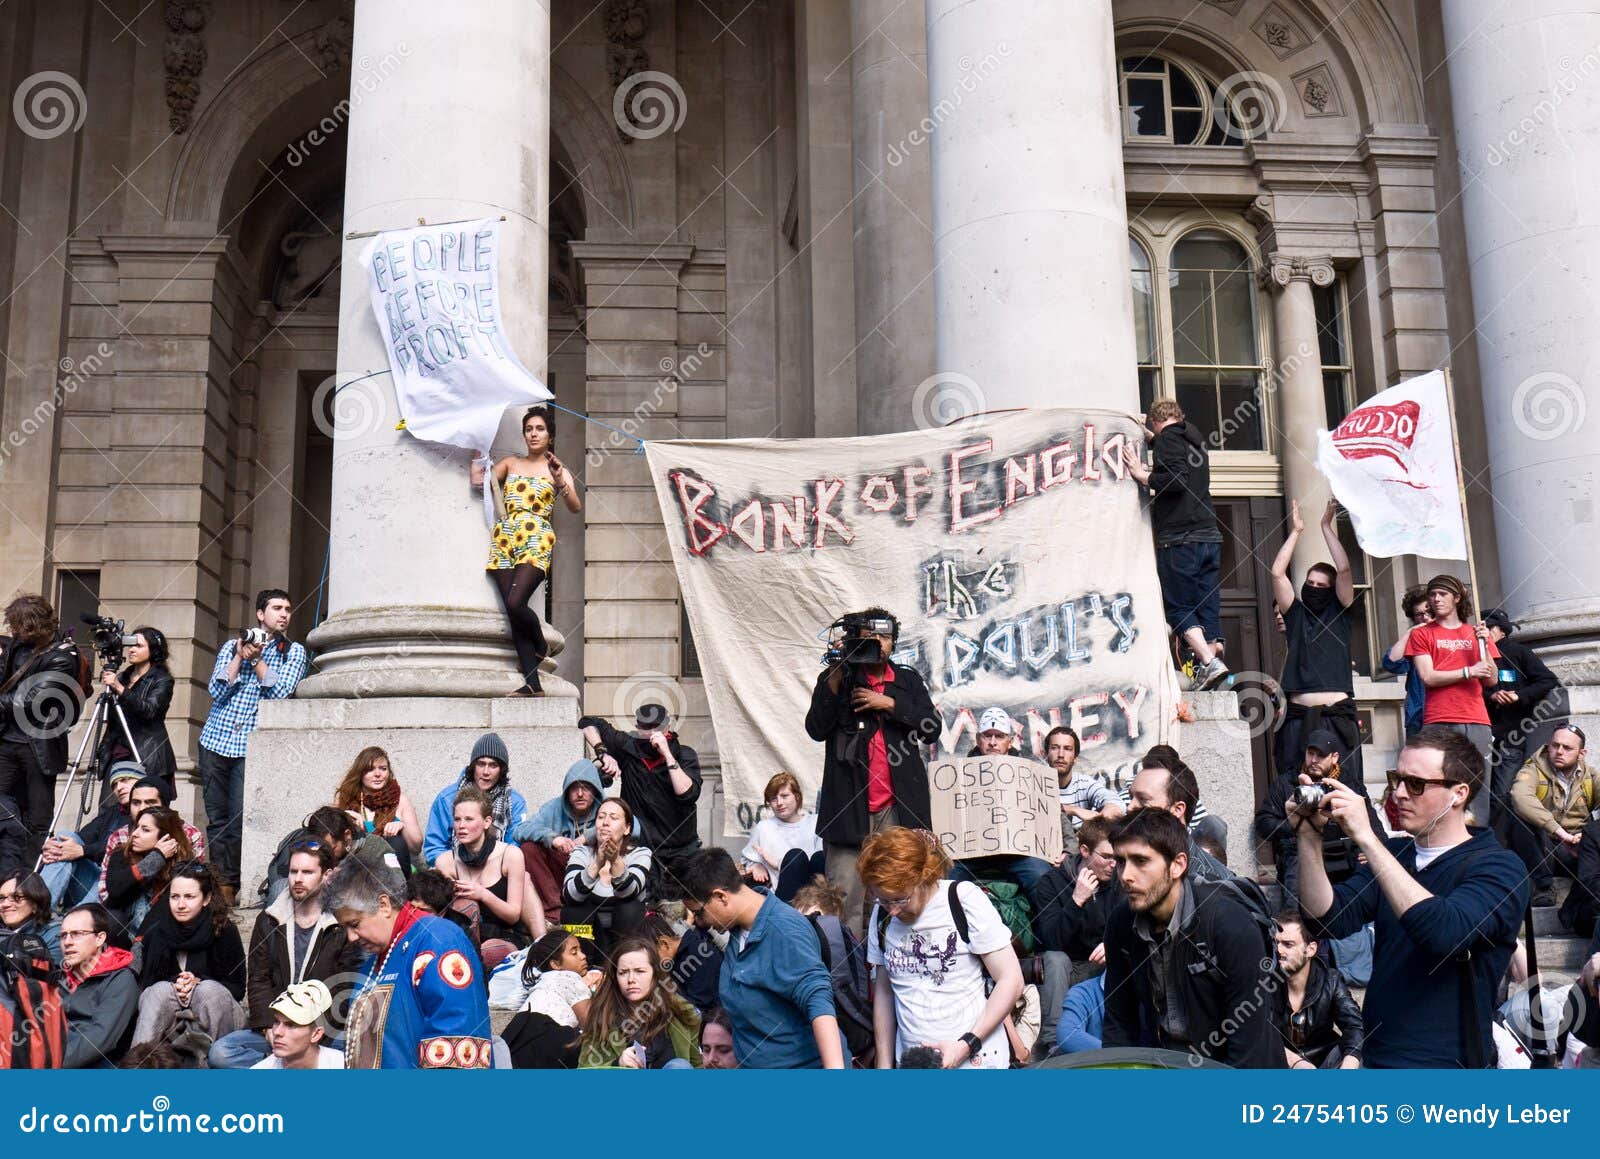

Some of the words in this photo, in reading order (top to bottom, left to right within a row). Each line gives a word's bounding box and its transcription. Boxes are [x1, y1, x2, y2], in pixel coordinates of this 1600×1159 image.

[372, 230, 493, 292] PEOPLE
[384, 280, 494, 343] BEFORE
[670, 471, 856, 557] BANK
[860, 465, 932, 521] OF
[930, 683, 1147, 760] MNEY
[933, 760, 1055, 798] OSBORNE
[954, 789, 1008, 810] BEST
